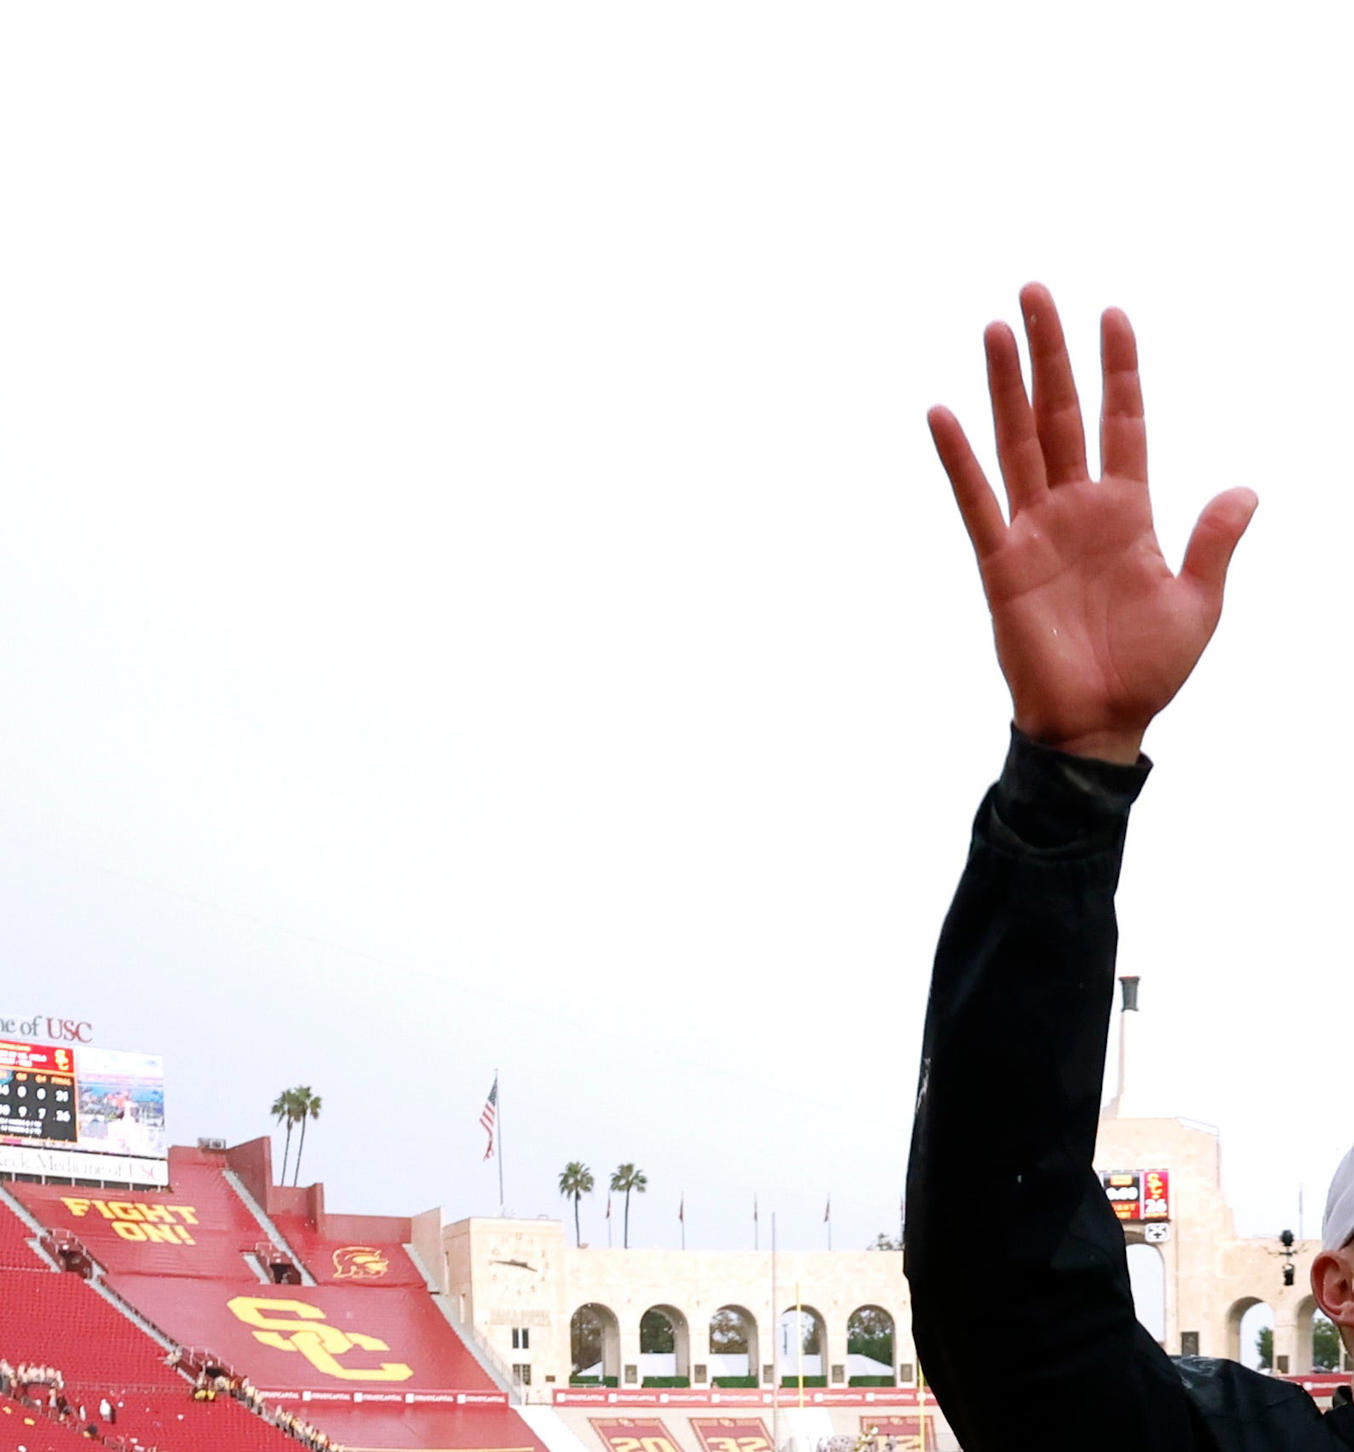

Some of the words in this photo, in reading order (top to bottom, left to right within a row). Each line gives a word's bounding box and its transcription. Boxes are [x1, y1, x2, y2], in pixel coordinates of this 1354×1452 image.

[20, 1015, 42, 1036] of
[47, 1017, 93, 1043] USC
[60, 1197, 199, 1224] FIGHT
[111, 1220, 196, 1246] ON!
[226, 1296, 414, 1381] SC
